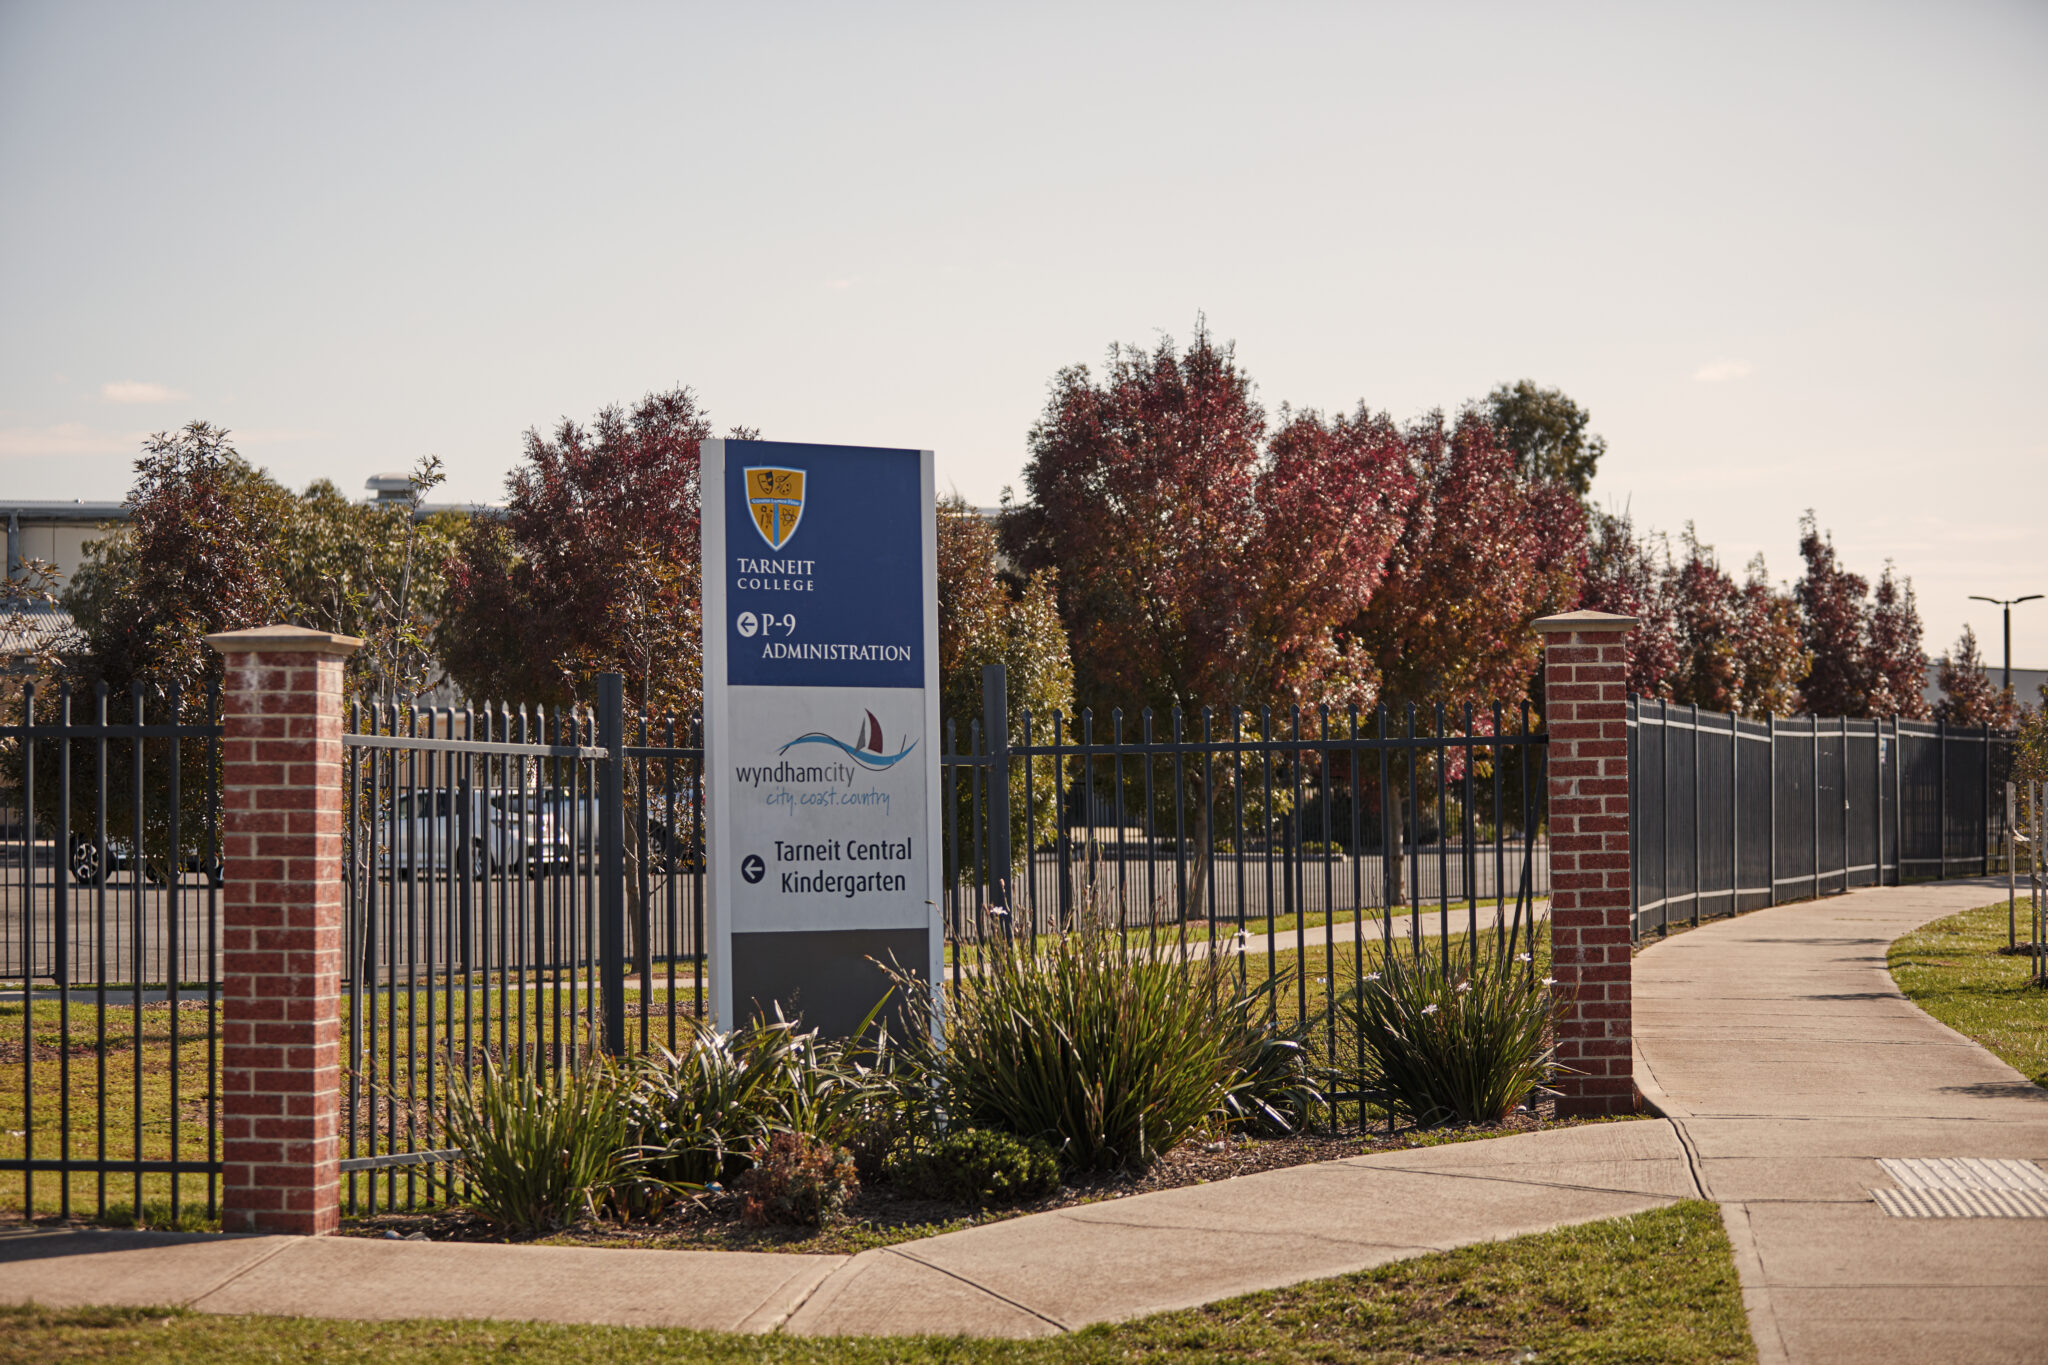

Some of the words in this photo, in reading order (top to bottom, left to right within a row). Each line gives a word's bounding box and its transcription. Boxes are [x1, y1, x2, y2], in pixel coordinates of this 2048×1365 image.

[737, 558, 815, 575] TARNEIT
[737, 578, 814, 591] COLLEGE
[761, 613, 796, 637] P-9
[762, 643, 911, 661] ADMINISTRATION
[736, 761, 855, 788] wyndhamcity
[774, 839, 841, 862] Tarneit
[846, 837, 912, 861] Central
[781, 869, 906, 898] Kindergarten
